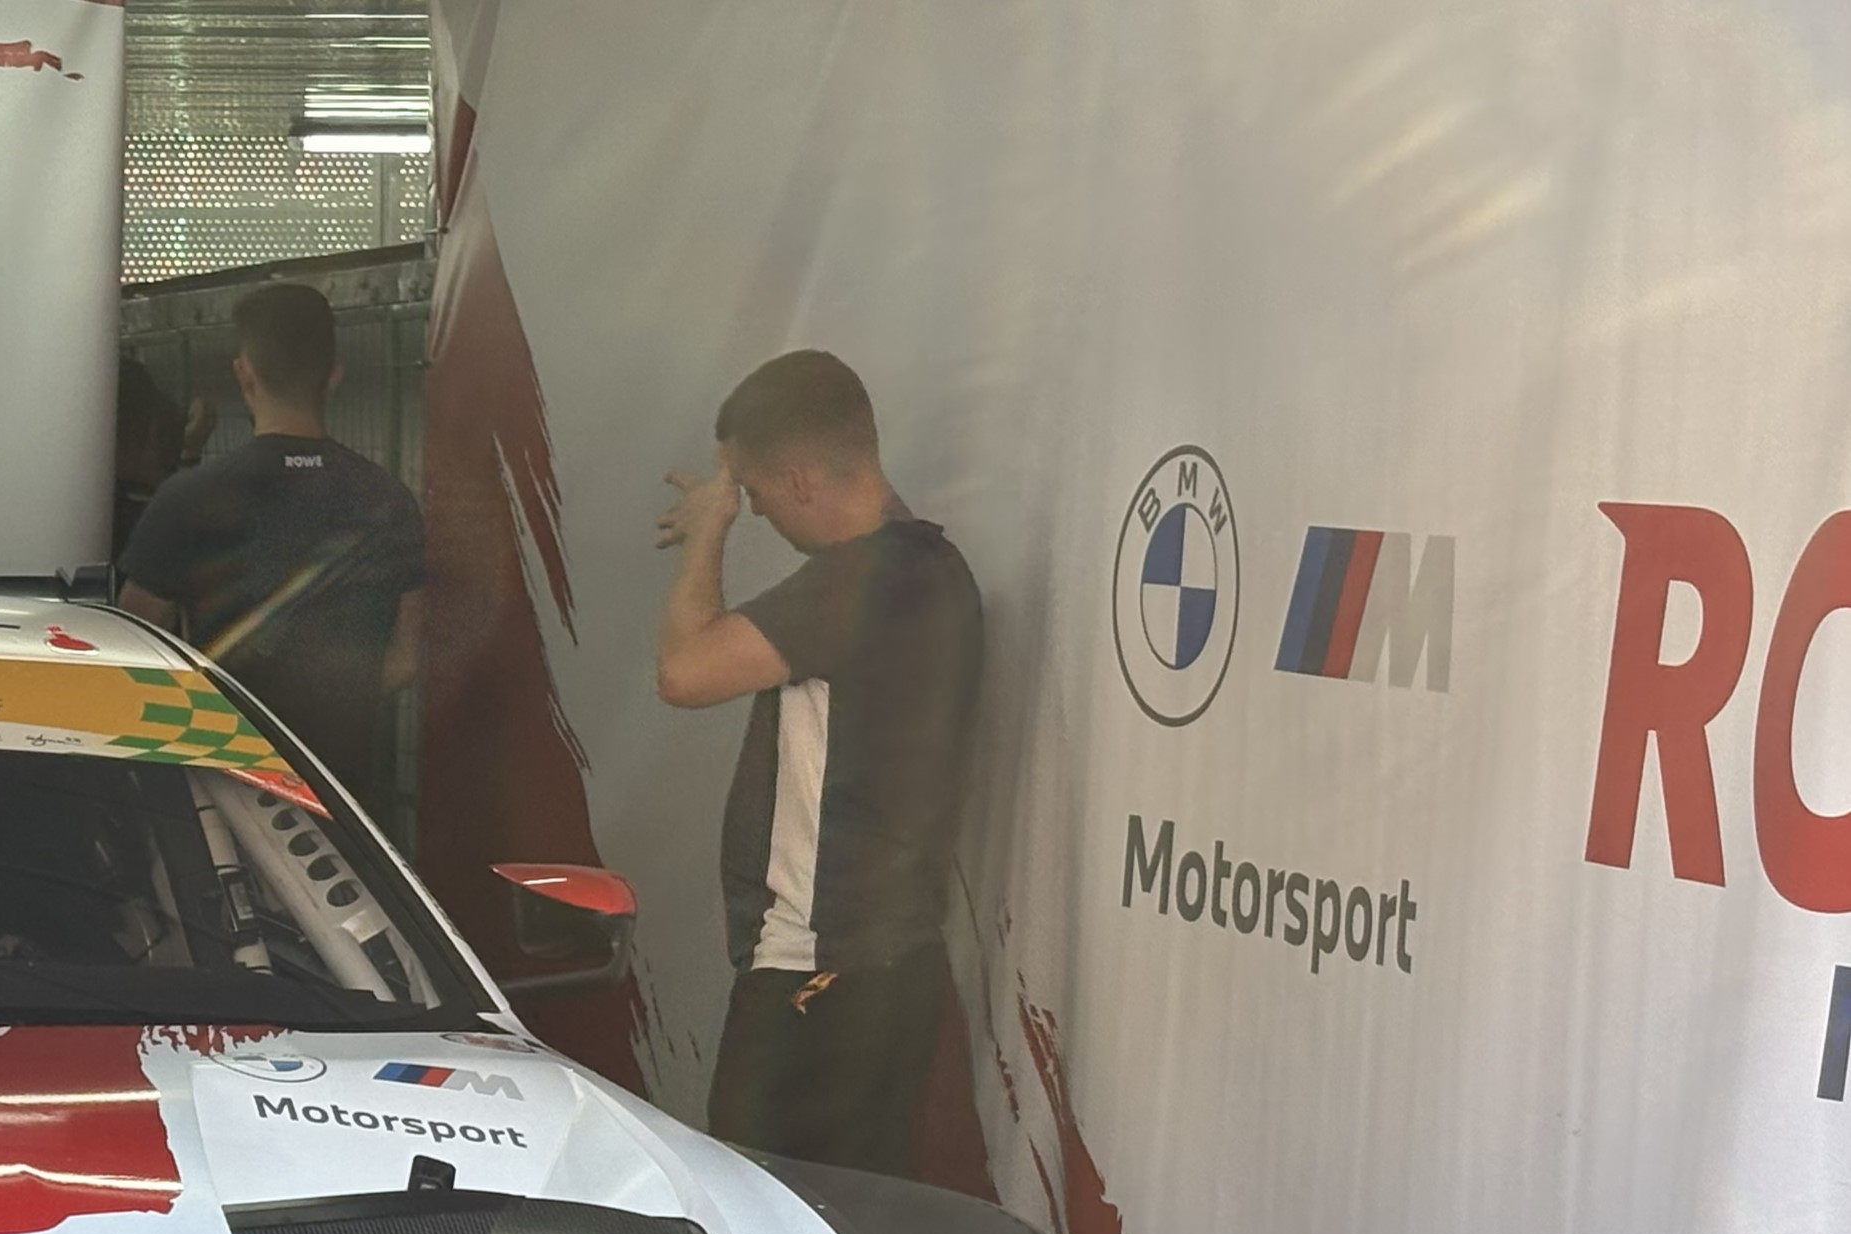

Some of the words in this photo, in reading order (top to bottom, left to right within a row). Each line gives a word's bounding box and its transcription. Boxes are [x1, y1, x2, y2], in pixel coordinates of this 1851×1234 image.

[1584, 501, 1851, 914] RO
[1121, 814, 1418, 974] Motorsport
[253, 1095, 528, 1149] Motorsport
